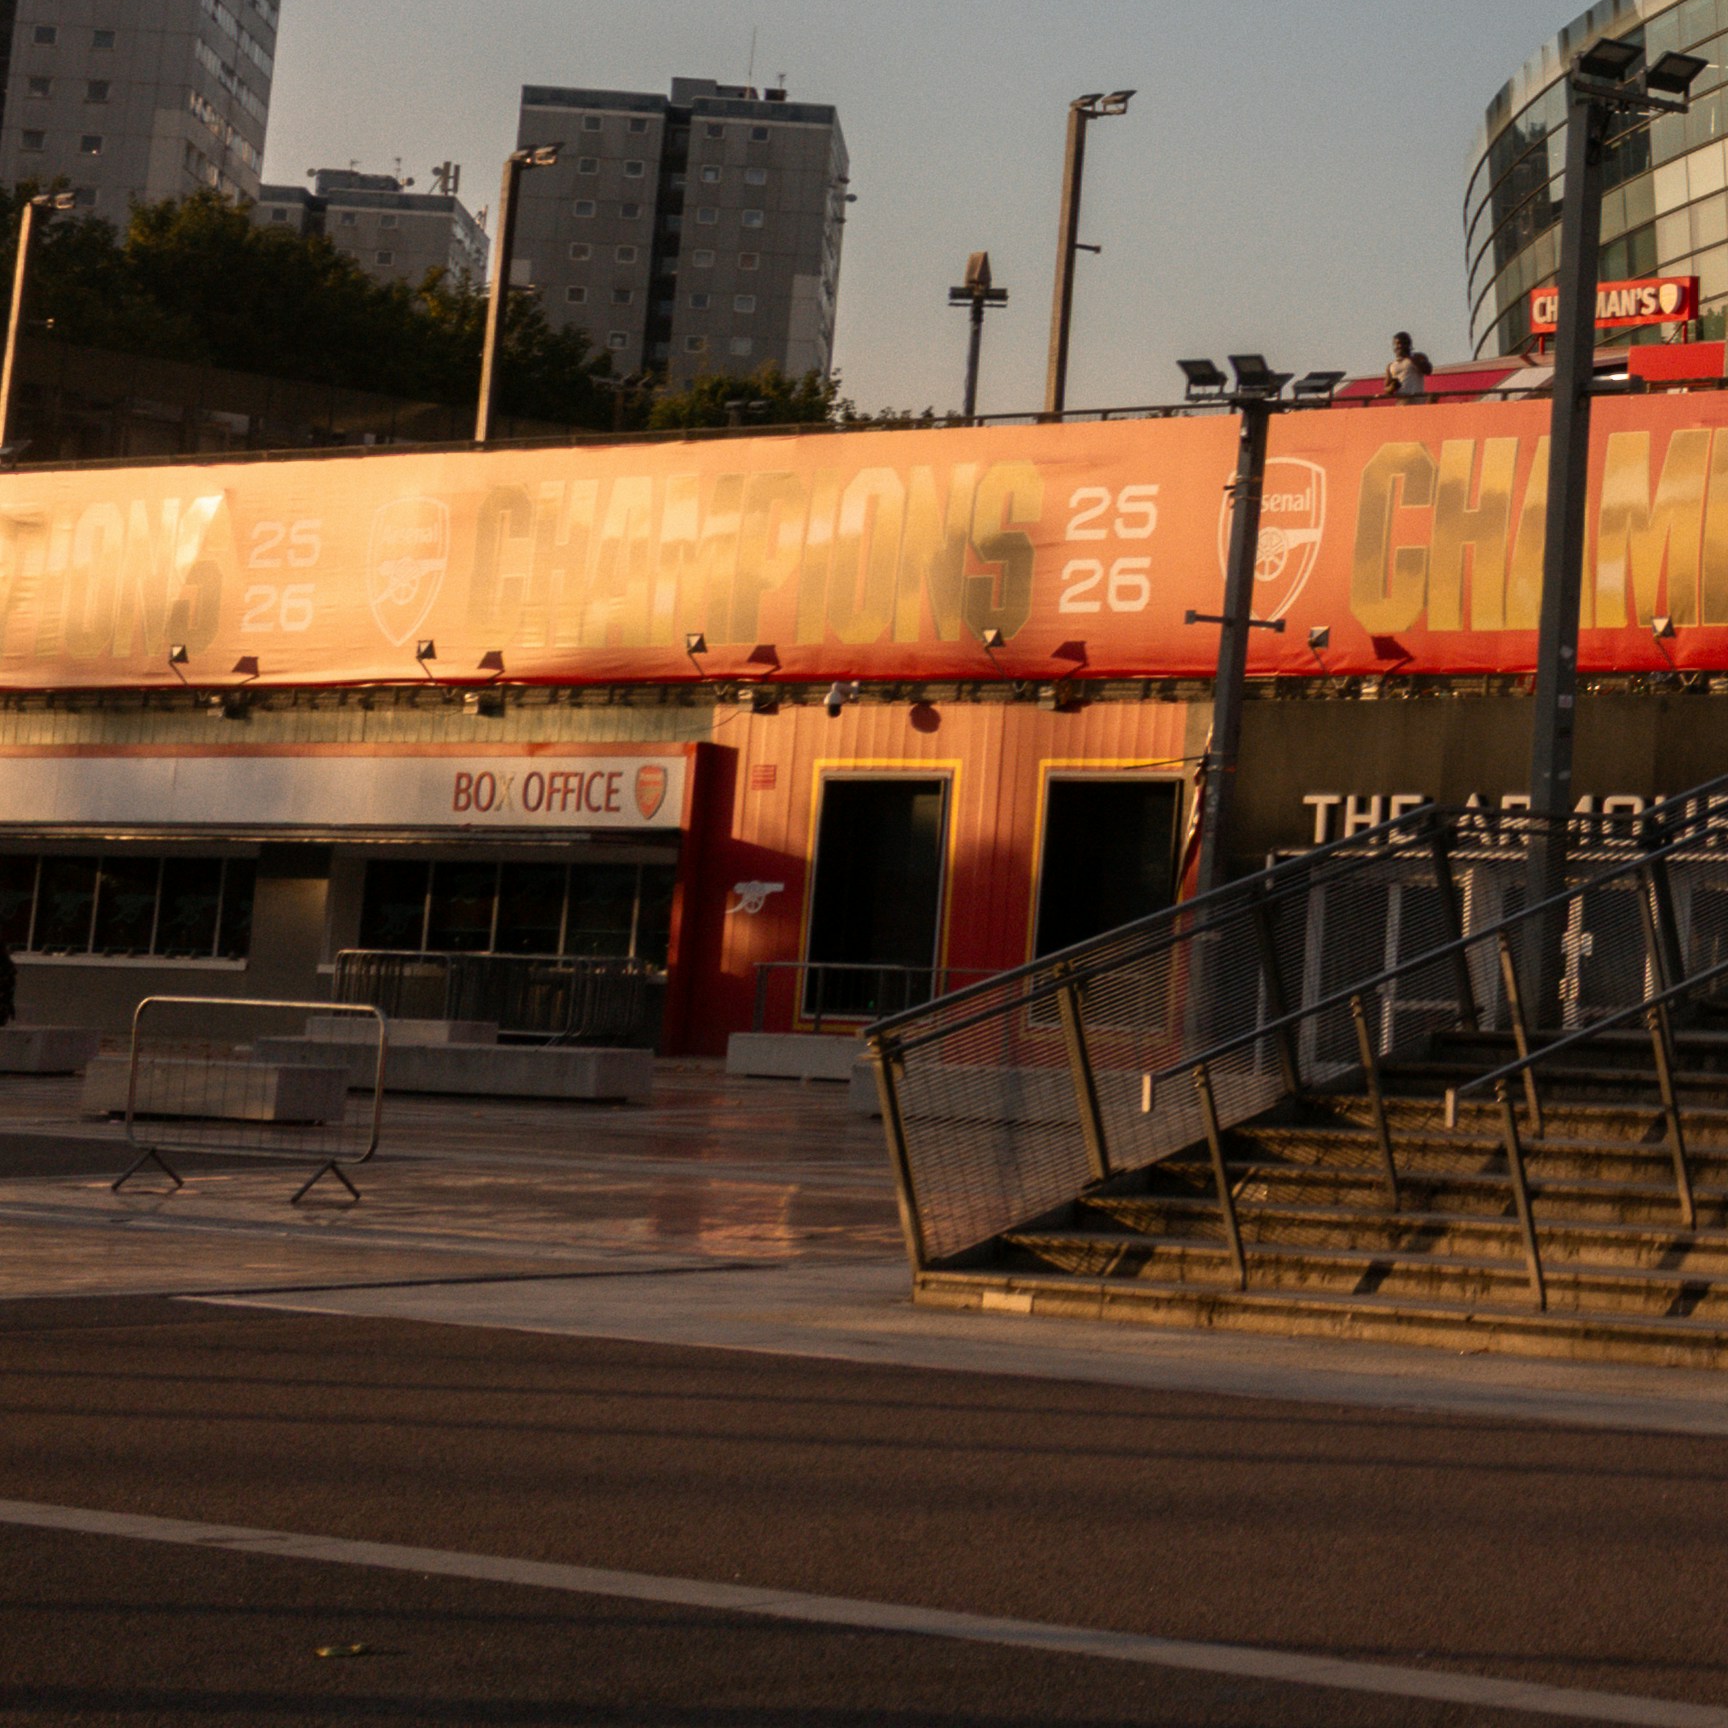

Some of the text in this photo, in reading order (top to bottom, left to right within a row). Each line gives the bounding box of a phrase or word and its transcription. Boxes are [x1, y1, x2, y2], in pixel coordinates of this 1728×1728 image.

[1532, 287, 1658, 325] CHAN'S
[1065, 484, 1161, 542] 25
[1260, 486, 1312, 514] senal
[249, 518, 323, 569] 25
[467, 458, 1045, 650] CHAMPIONS
[240, 582, 317, 634] 26
[1058, 556, 1152, 614] 26
[453, 771, 623, 812] BOX OFFICE
[1303, 793, 1425, 846] THE
